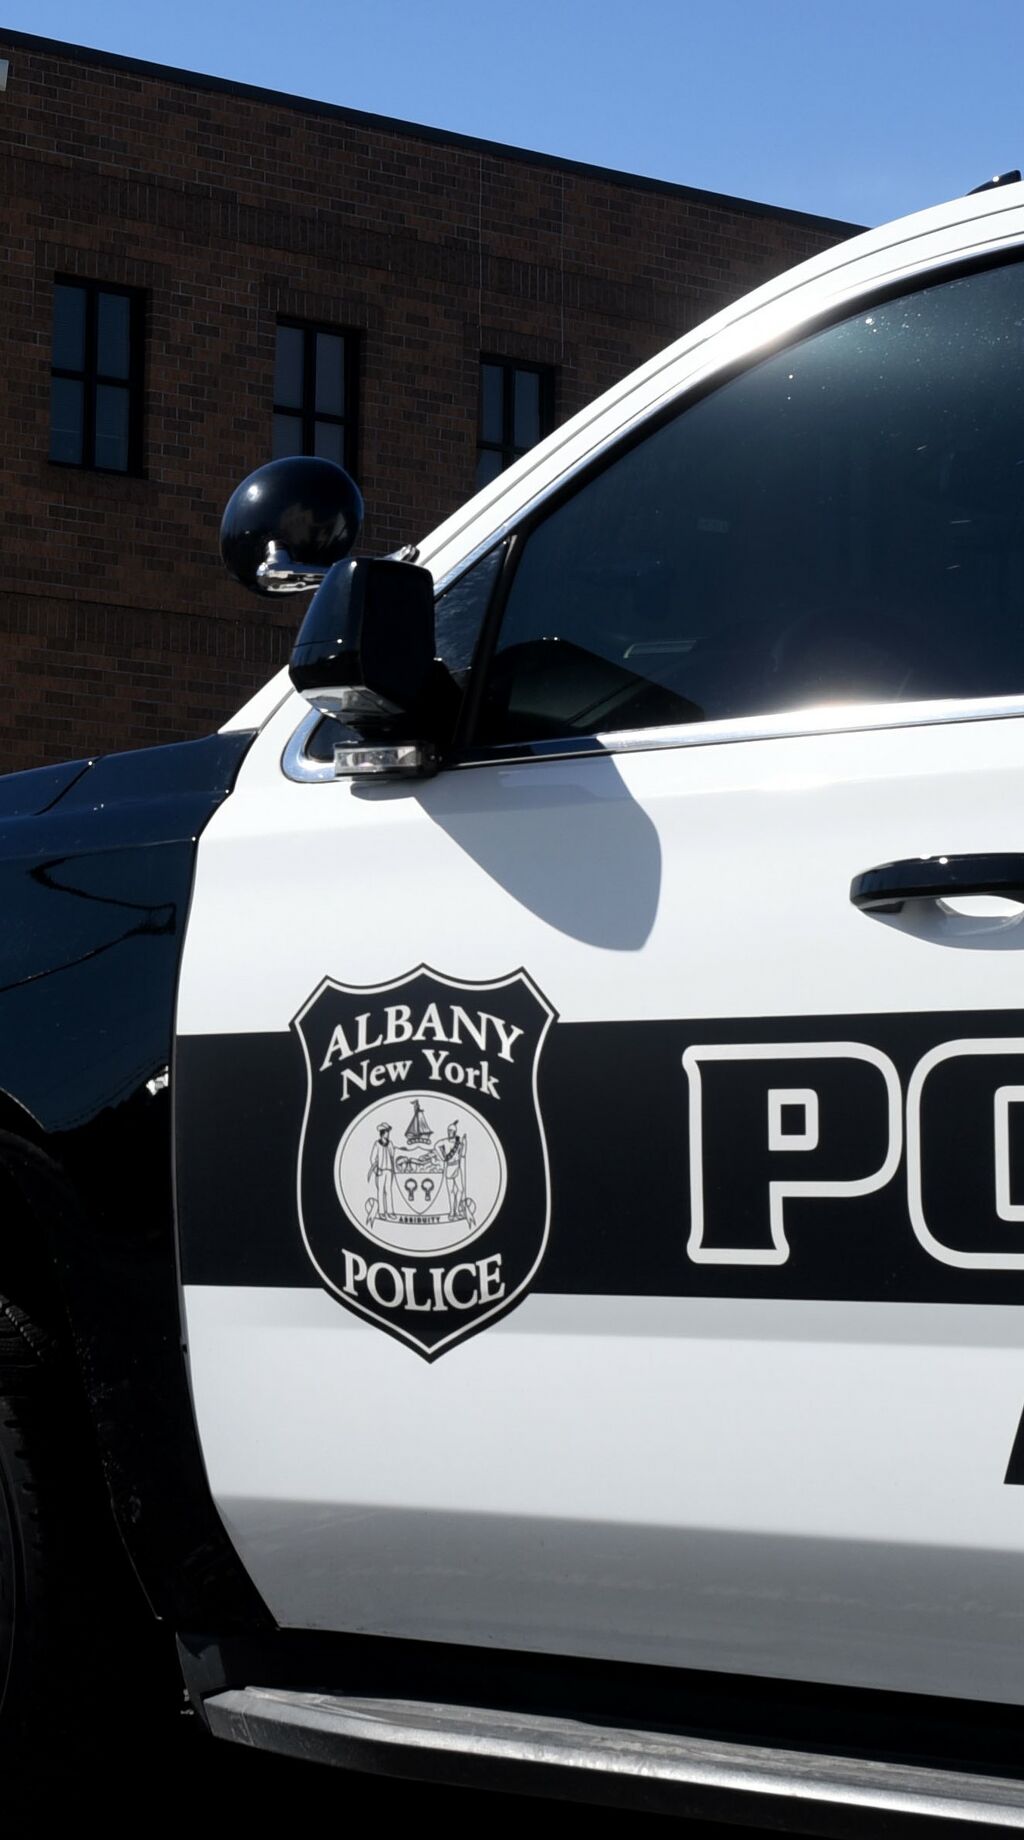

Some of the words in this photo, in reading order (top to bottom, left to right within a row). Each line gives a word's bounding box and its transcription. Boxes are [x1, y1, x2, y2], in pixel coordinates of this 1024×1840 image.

[319, 1002, 525, 1072] ALBANY
[340, 1059, 414, 1101] New
[421, 1048, 501, 1100] York
[341, 1248, 506, 1312] POLICE
